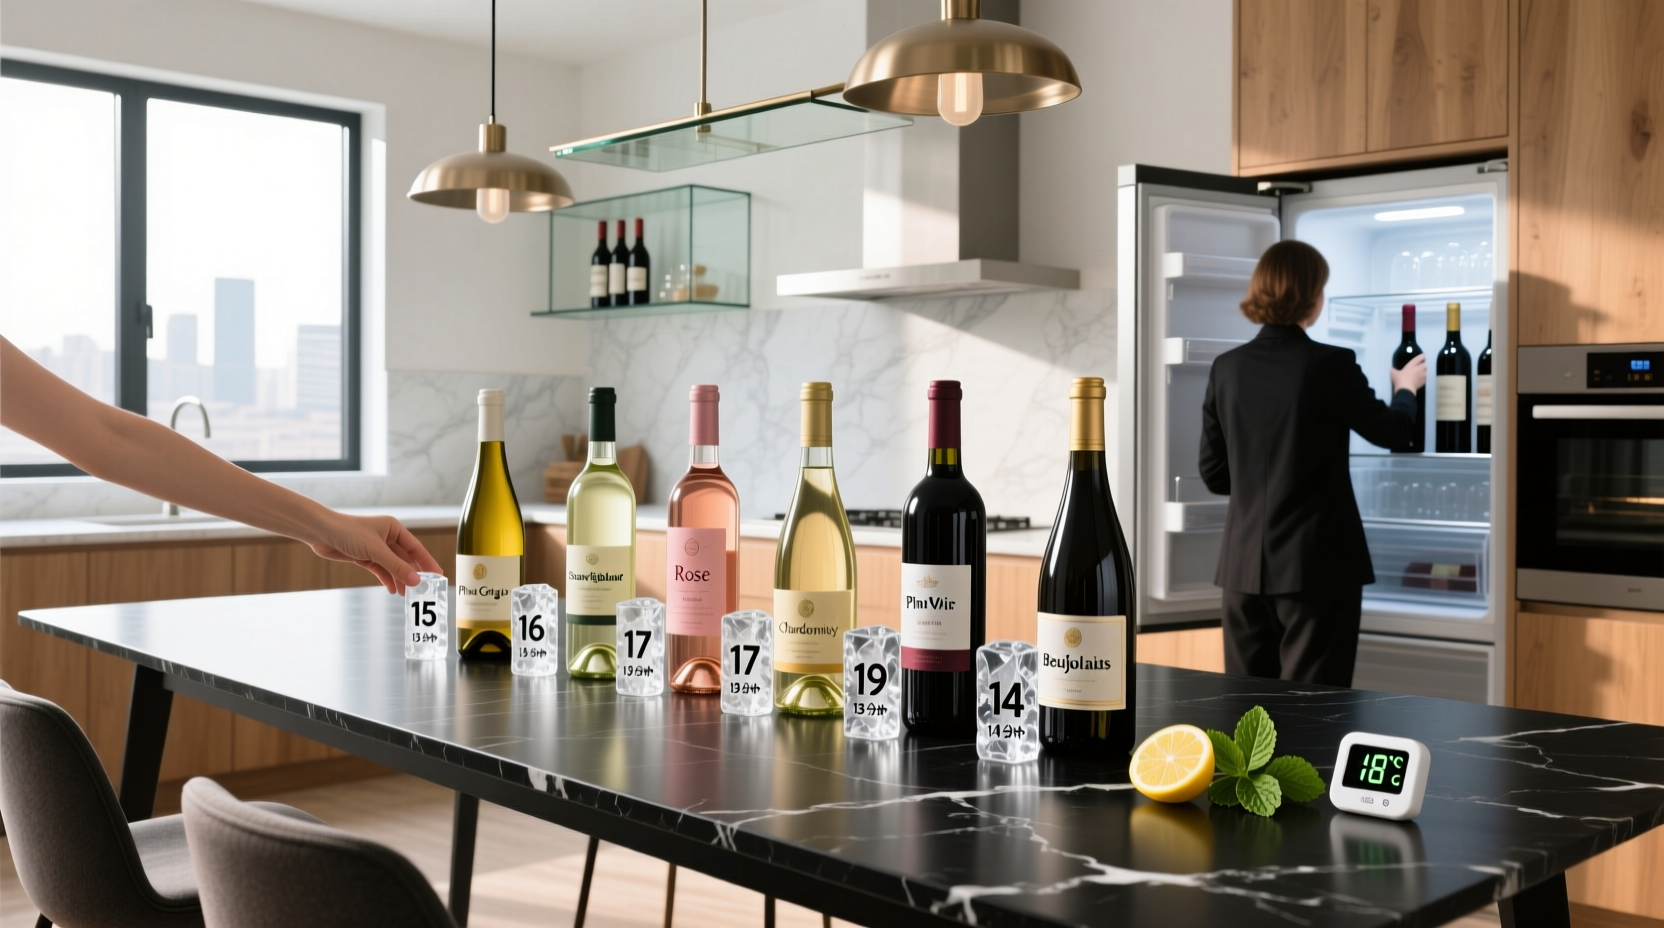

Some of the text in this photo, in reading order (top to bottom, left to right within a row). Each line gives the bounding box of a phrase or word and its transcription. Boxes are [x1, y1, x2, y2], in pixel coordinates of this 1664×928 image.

[674, 565, 711, 582] Rose
[411, 601, 437, 627] 15
[518, 614, 545, 642] 16
[624, 629, 652, 659] 17
[730, 644, 760, 675] 17
[853, 662, 888, 696] 19
[988, 680, 1025, 718] 14
